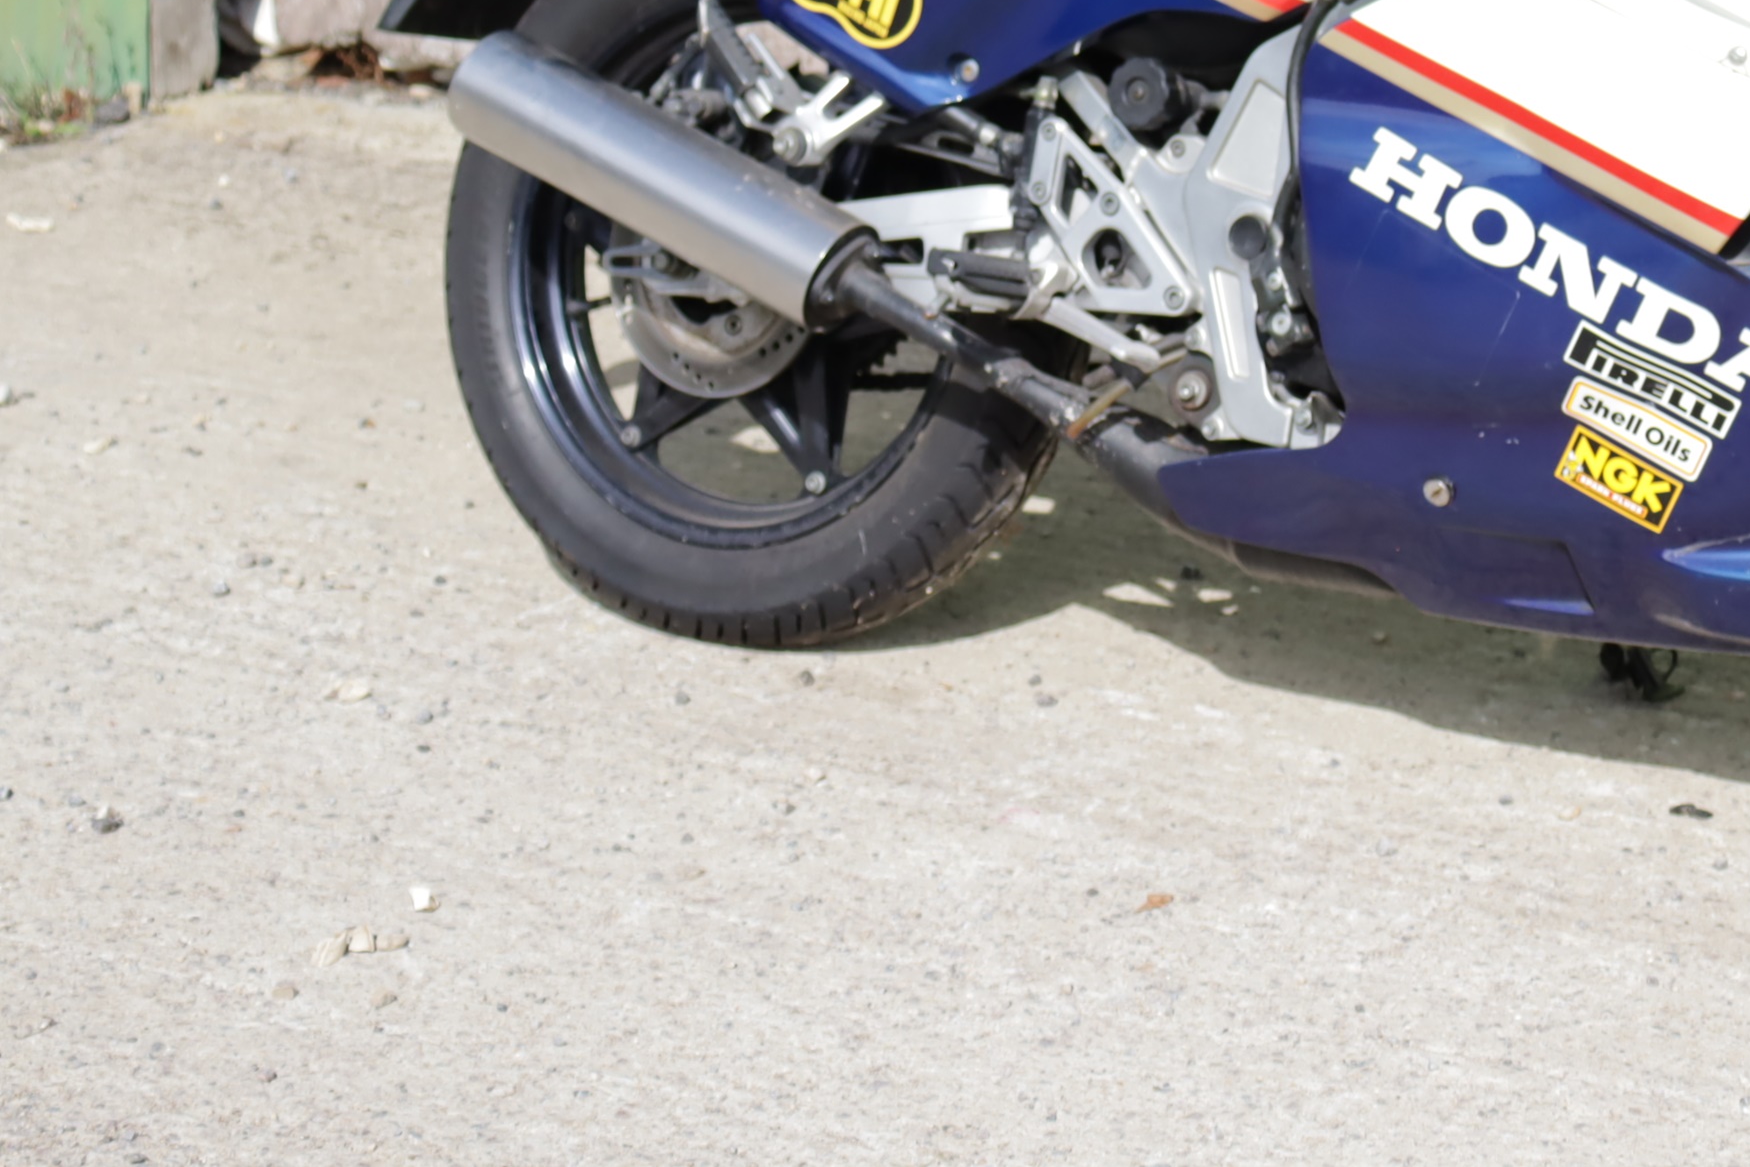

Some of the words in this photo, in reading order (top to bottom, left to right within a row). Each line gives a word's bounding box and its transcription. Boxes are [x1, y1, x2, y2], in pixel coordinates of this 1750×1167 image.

[1568, 325, 1736, 433] PIRELLI
[1579, 394, 1643, 436] Shell
[1645, 426, 1692, 463] Oils
[1574, 435, 1672, 514] NGK
